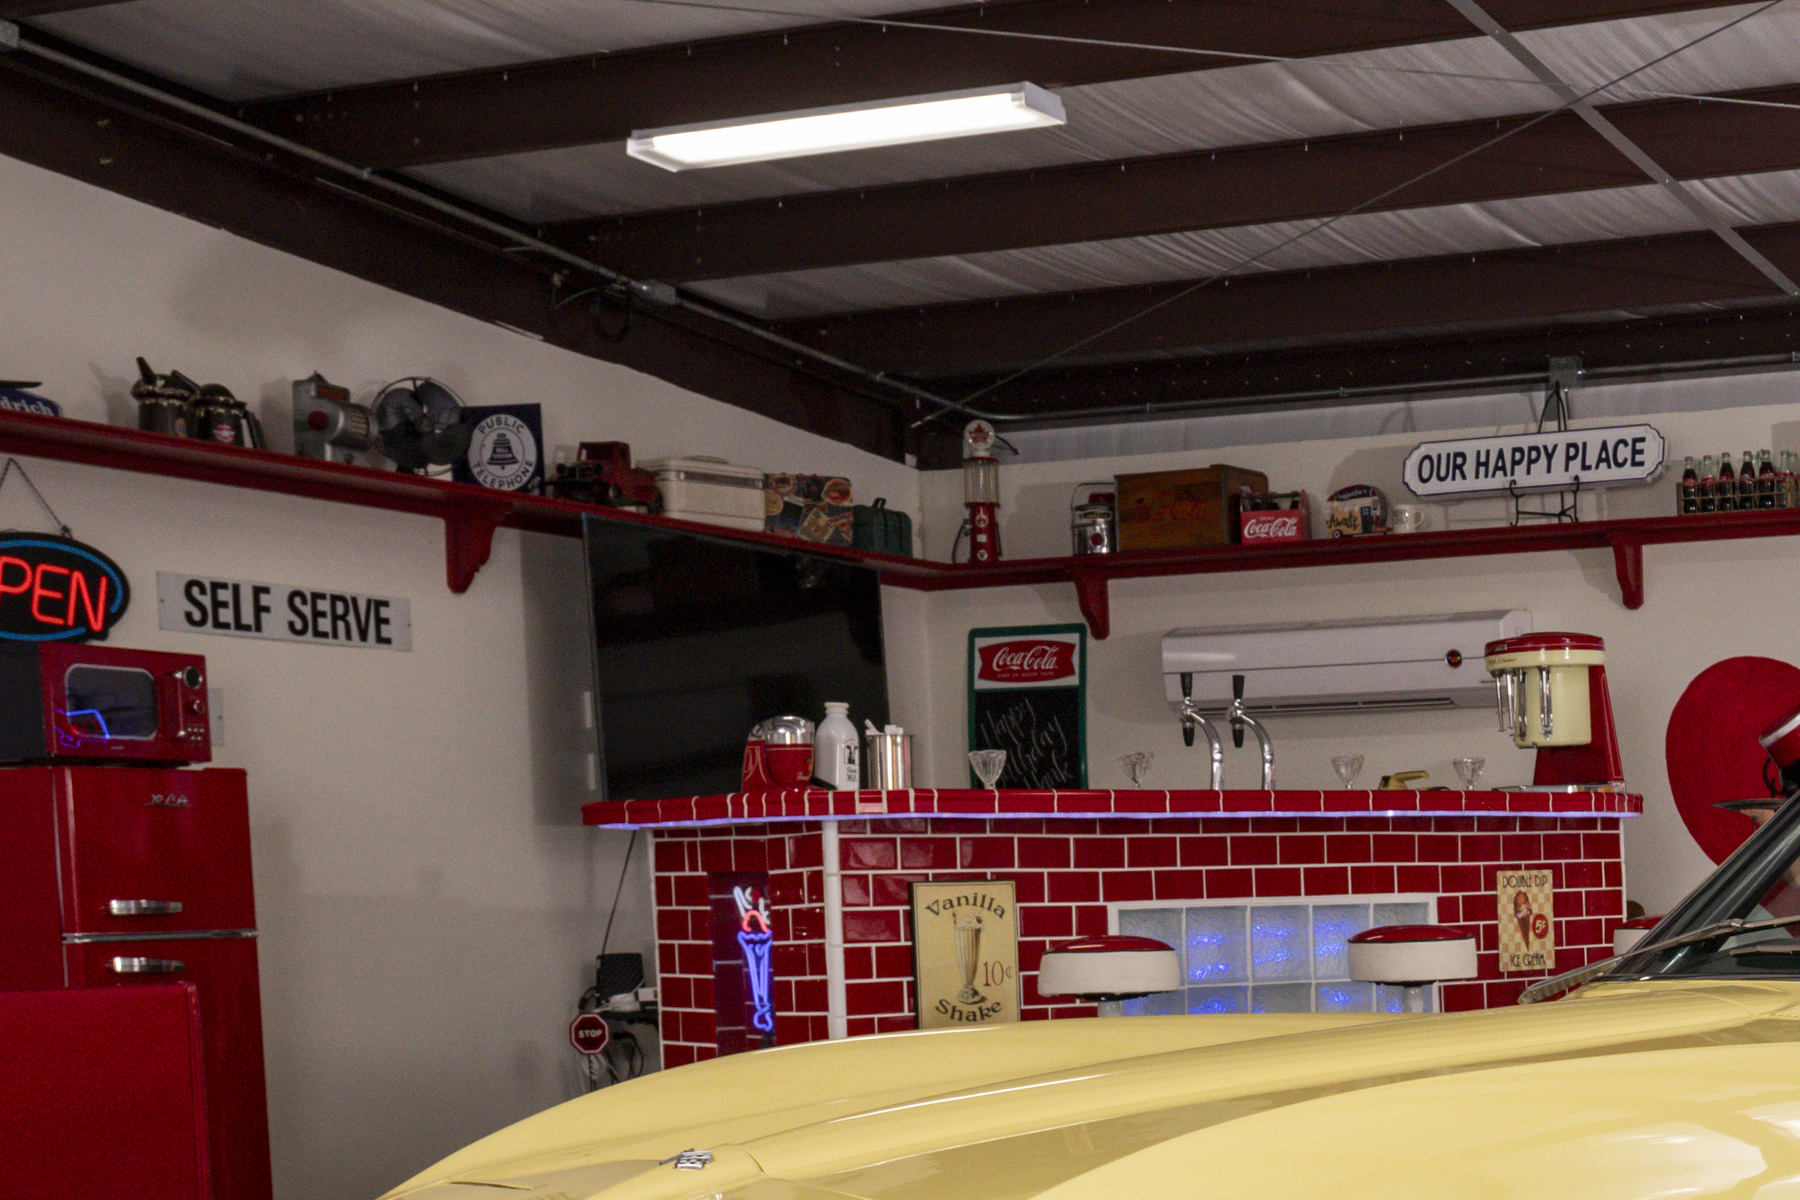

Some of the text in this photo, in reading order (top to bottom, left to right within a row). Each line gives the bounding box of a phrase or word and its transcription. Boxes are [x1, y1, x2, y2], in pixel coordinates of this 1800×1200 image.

[478, 416, 525, 435] PUBLIC
[1417, 436, 1647, 485] OUR HAPPY PLACE
[472, 460, 534, 489] TELEPHONE
[1244, 516, 1299, 539] Coca-Cola
[184, 579, 393, 645] SELF SERVE
[992, 645, 1061, 672] Coca-Cola
[1502, 874, 1548, 889] DOUBLE DIP
[925, 892, 1006, 920] Vanilla
[1535, 919, 1546, 934] 5¢
[1510, 953, 1546, 968] ICE CREAM
[983, 960, 1013, 987] 10¢
[934, 998, 1003, 1023] Shake
[578, 1029, 603, 1039] STOP
